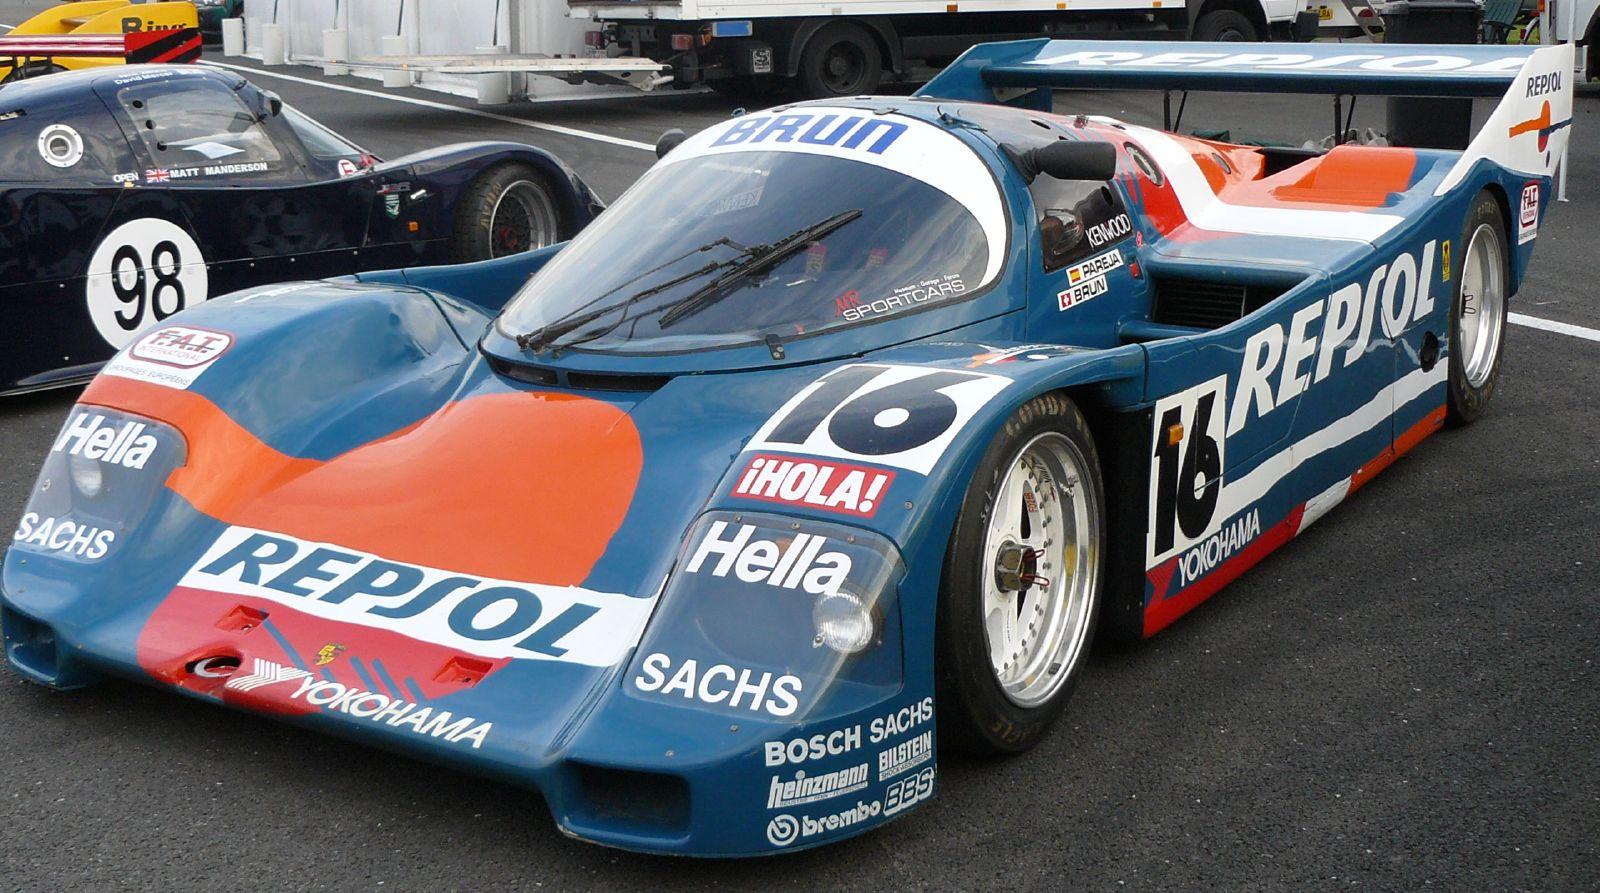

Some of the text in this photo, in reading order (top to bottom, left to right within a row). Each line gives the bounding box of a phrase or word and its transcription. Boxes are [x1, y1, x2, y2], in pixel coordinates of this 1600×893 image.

[1526, 71, 1562, 98] REPSOL
[709, 114, 908, 155] BRUN
[113, 172, 139, 183] OPEN
[169, 162, 268, 178] MATT MANDERSON
[1085, 213, 1131, 248] KENWOOD
[111, 240, 186, 331] 98
[1082, 253, 1121, 278] PAREJA
[842, 279, 966, 321] SPORTCARS
[1073, 278, 1106, 302] BRUN
[1225, 239, 1437, 439] REPSOL
[765, 365, 990, 456] 16
[53, 412, 158, 470] Hella
[736, 457, 888, 513] ¡HOLA!
[1152, 388, 1223, 558] 16
[14, 512, 115, 559] SACHS
[685, 520, 852, 596] Hella
[1176, 507, 1261, 588] YOKOHAMA
[198, 533, 602, 658] REPSOL
[635, 652, 802, 717] SACHS
[294, 672, 495, 750] YOKOHAMA
[869, 696, 933, 743] SACHS
[765, 725, 861, 767] BOSCH
[879, 730, 931, 772] BILSTEIN
[767, 763, 869, 809] heinzmann
[883, 767, 935, 817] BBS
[802, 801, 881, 837] brembo
